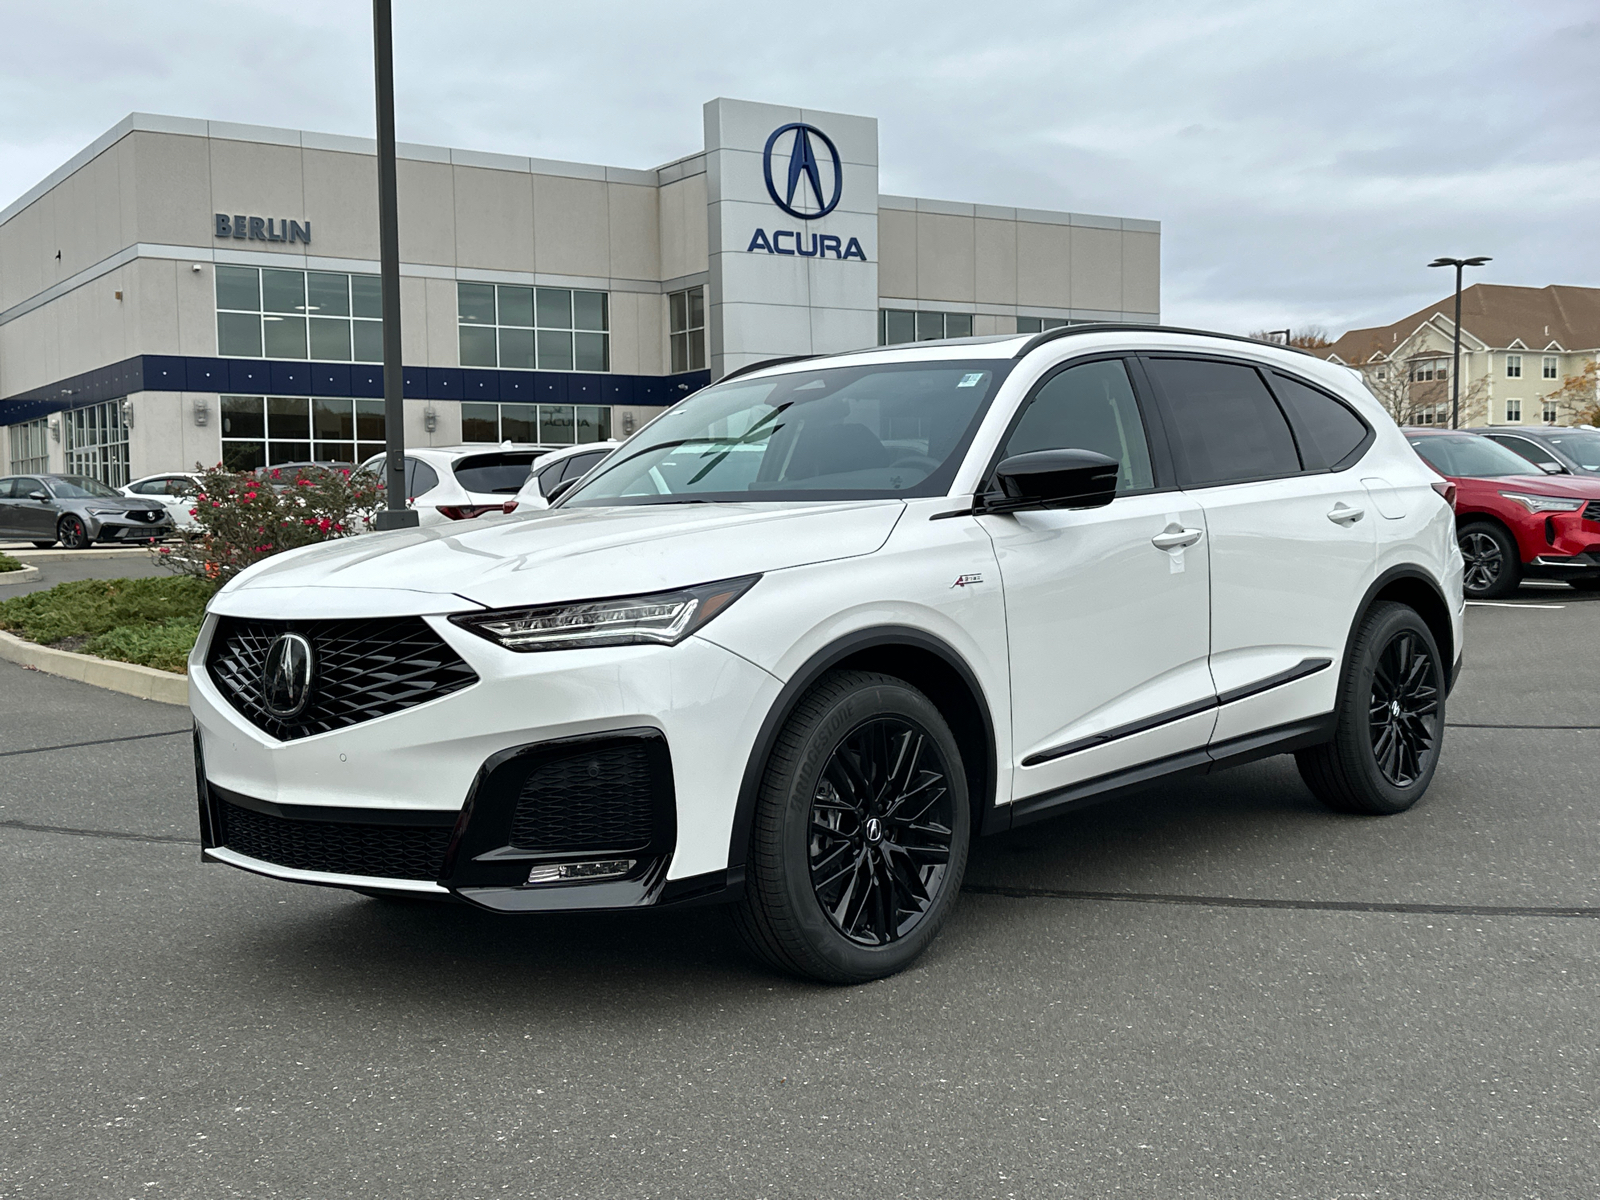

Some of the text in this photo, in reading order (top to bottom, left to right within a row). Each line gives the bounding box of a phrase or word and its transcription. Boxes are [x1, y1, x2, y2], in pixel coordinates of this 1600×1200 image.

[215, 213, 311, 244] BERLIN
[747, 228, 867, 261] ACURA
[790, 702, 855, 814] BRIDGESTONE
